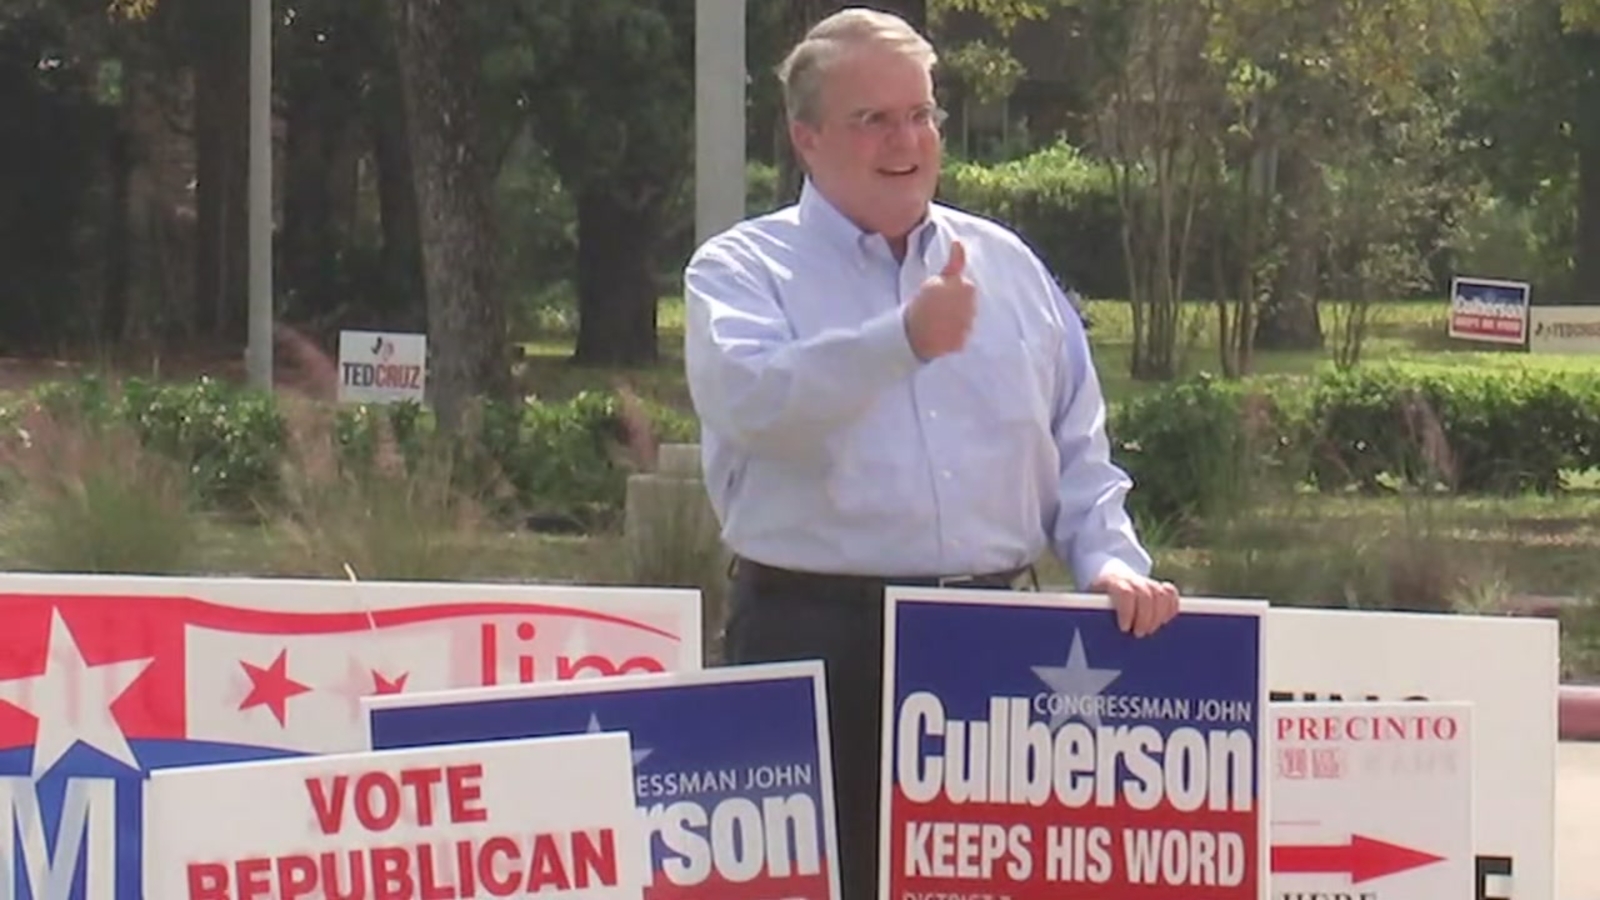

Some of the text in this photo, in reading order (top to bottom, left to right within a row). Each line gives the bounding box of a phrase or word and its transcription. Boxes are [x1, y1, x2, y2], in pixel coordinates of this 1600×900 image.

[1034, 692, 1251, 722] CONGRESSMAN JOHN
[1277, 716, 1458, 742] PRECINTO
[636, 763, 812, 798] ESSMAN JOHN
[899, 690, 1252, 812] Culberson
[305, 763, 488, 835] VOTE
[186, 828, 618, 900] REPUBLICAN
[637, 792, 821, 888] rson
[904, 821, 1246, 887] KEEPS HIS WORD
